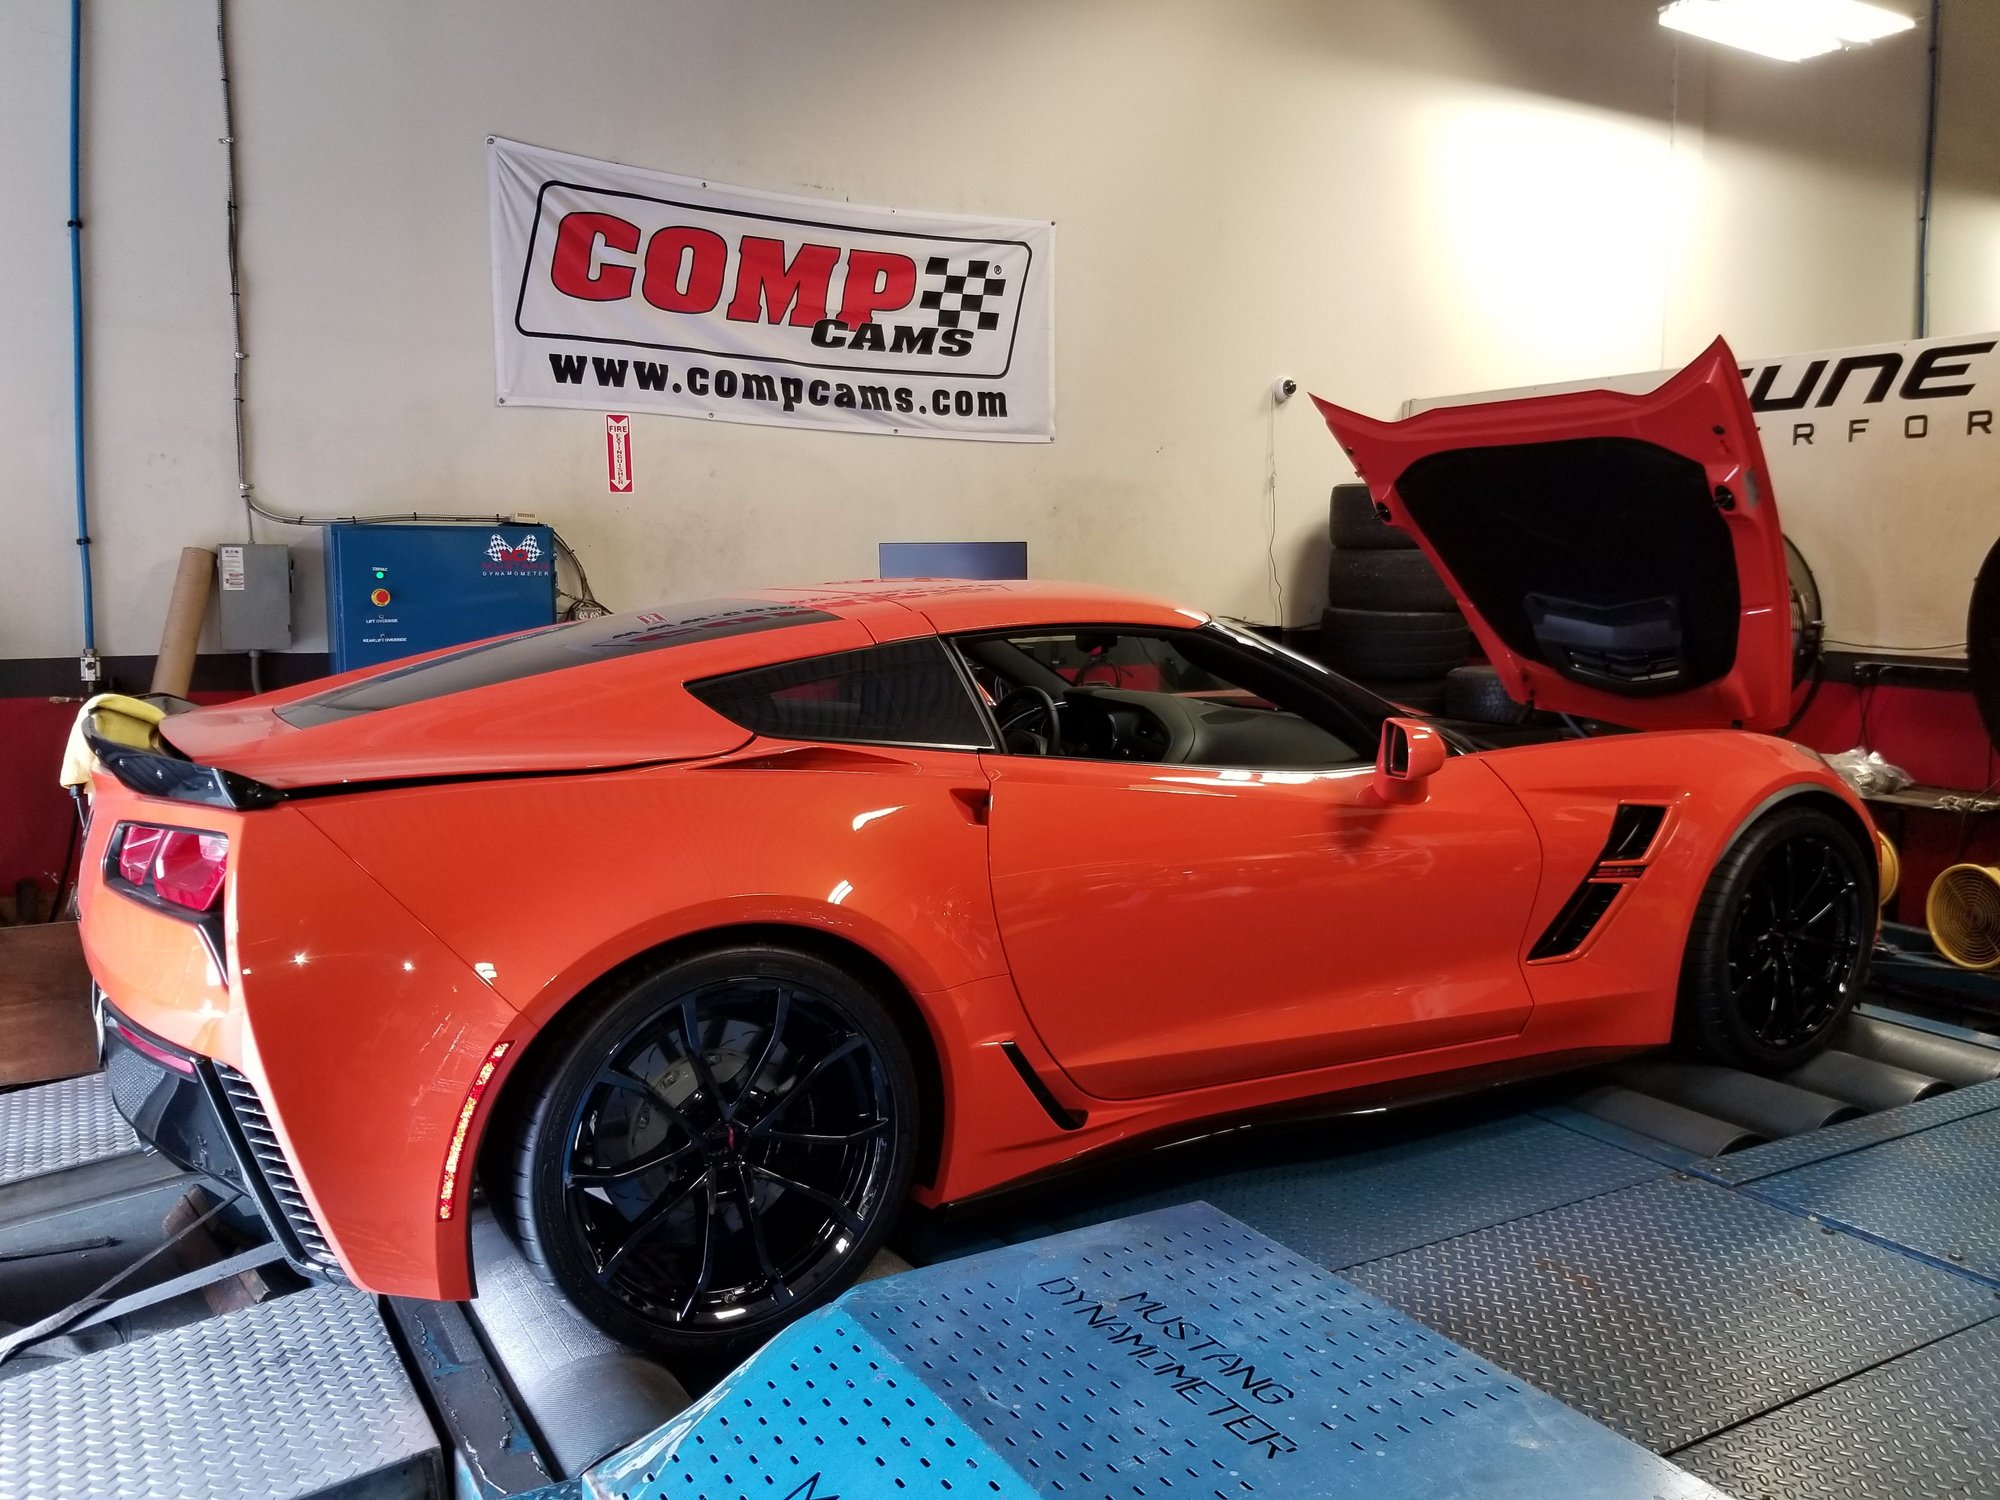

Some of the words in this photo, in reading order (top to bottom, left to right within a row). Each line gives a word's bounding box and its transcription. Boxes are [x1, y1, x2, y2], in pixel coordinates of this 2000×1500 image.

[551, 211, 918, 332] COMP
[809, 318, 975, 358] CAMS
[548, 353, 1008, 418] www.compcams.com
[1739, 340, 1999, 413] UNE
[609, 425, 628, 433] FIRE
[616, 433, 624, 485] EXTINGUISHER
[1037, 1276, 1299, 1460] DYNAMOMETER
[1118, 1290, 1295, 1405] MUSTANG
